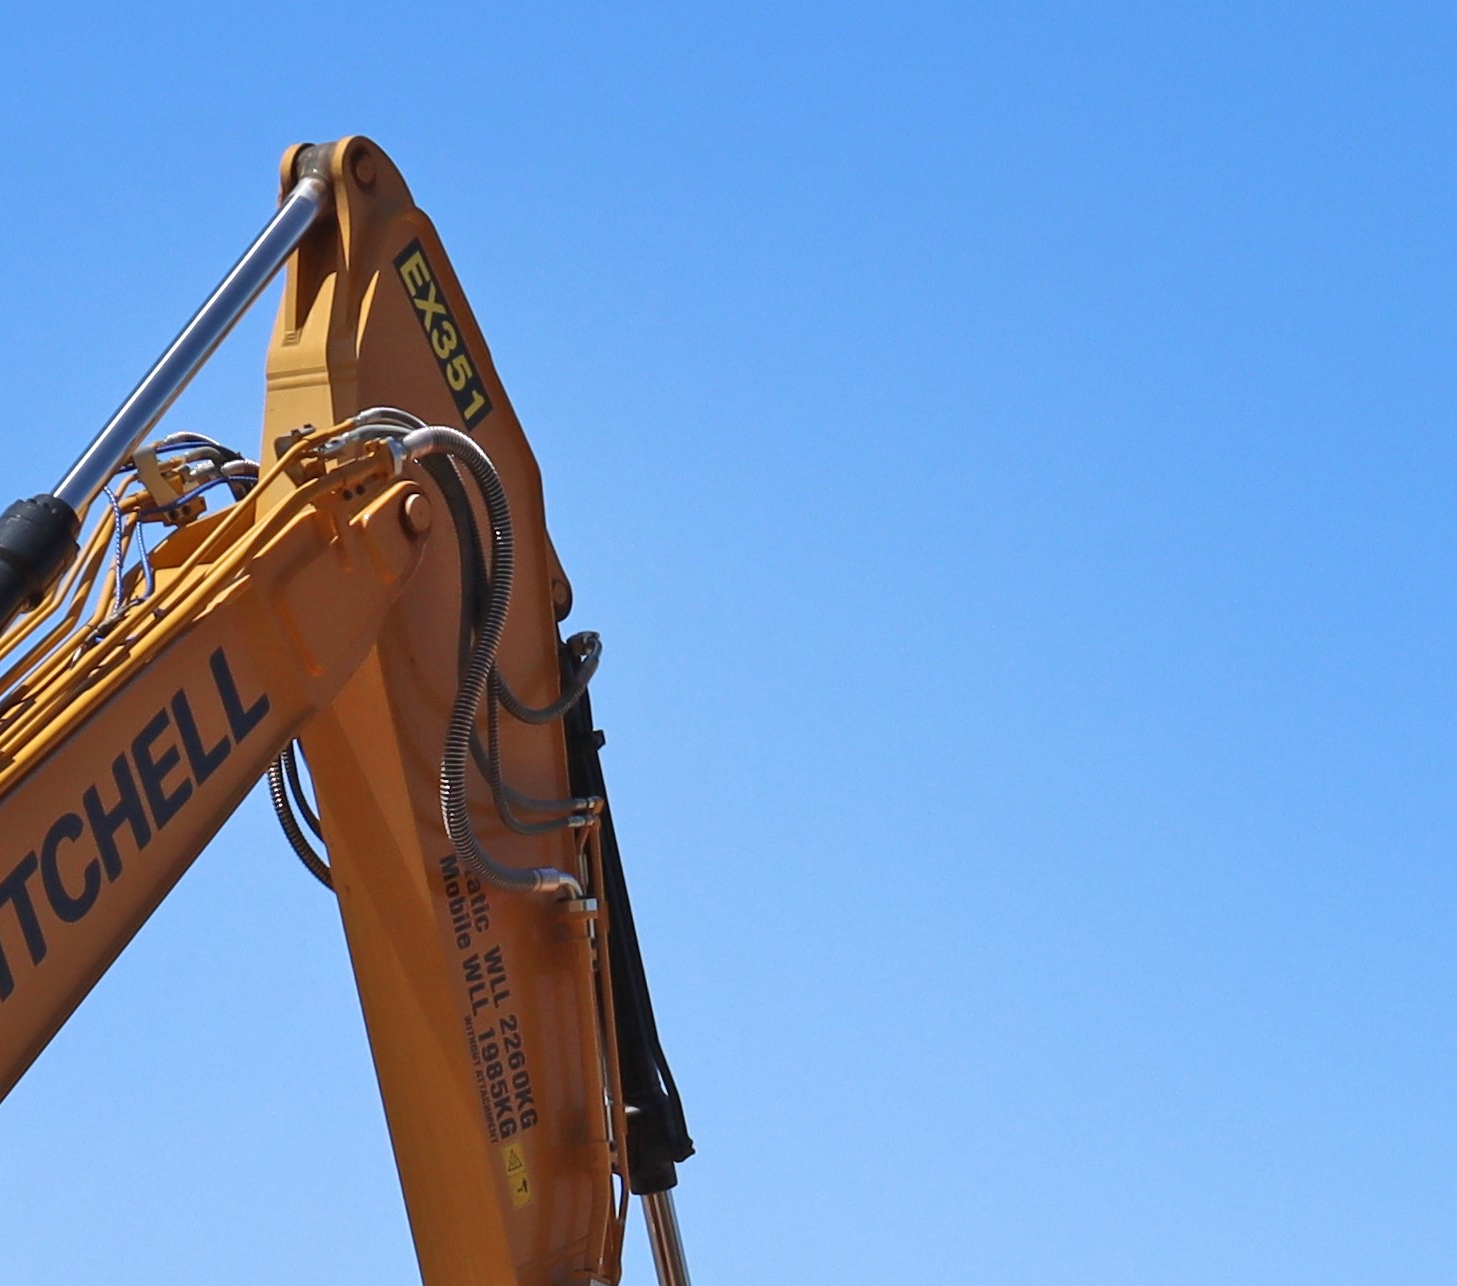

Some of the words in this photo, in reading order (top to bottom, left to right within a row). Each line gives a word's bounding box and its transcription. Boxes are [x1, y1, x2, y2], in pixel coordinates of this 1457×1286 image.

[400, 250, 485, 420] EX351
[439, 854, 472, 950] Mobile
[462, 953, 489, 1017] WLL
[478, 1027, 517, 1139] 1985KG
[465, 870, 490, 933] atic
[483, 945, 510, 1008] WLL
[500, 1014, 538, 1131] 2260KG
